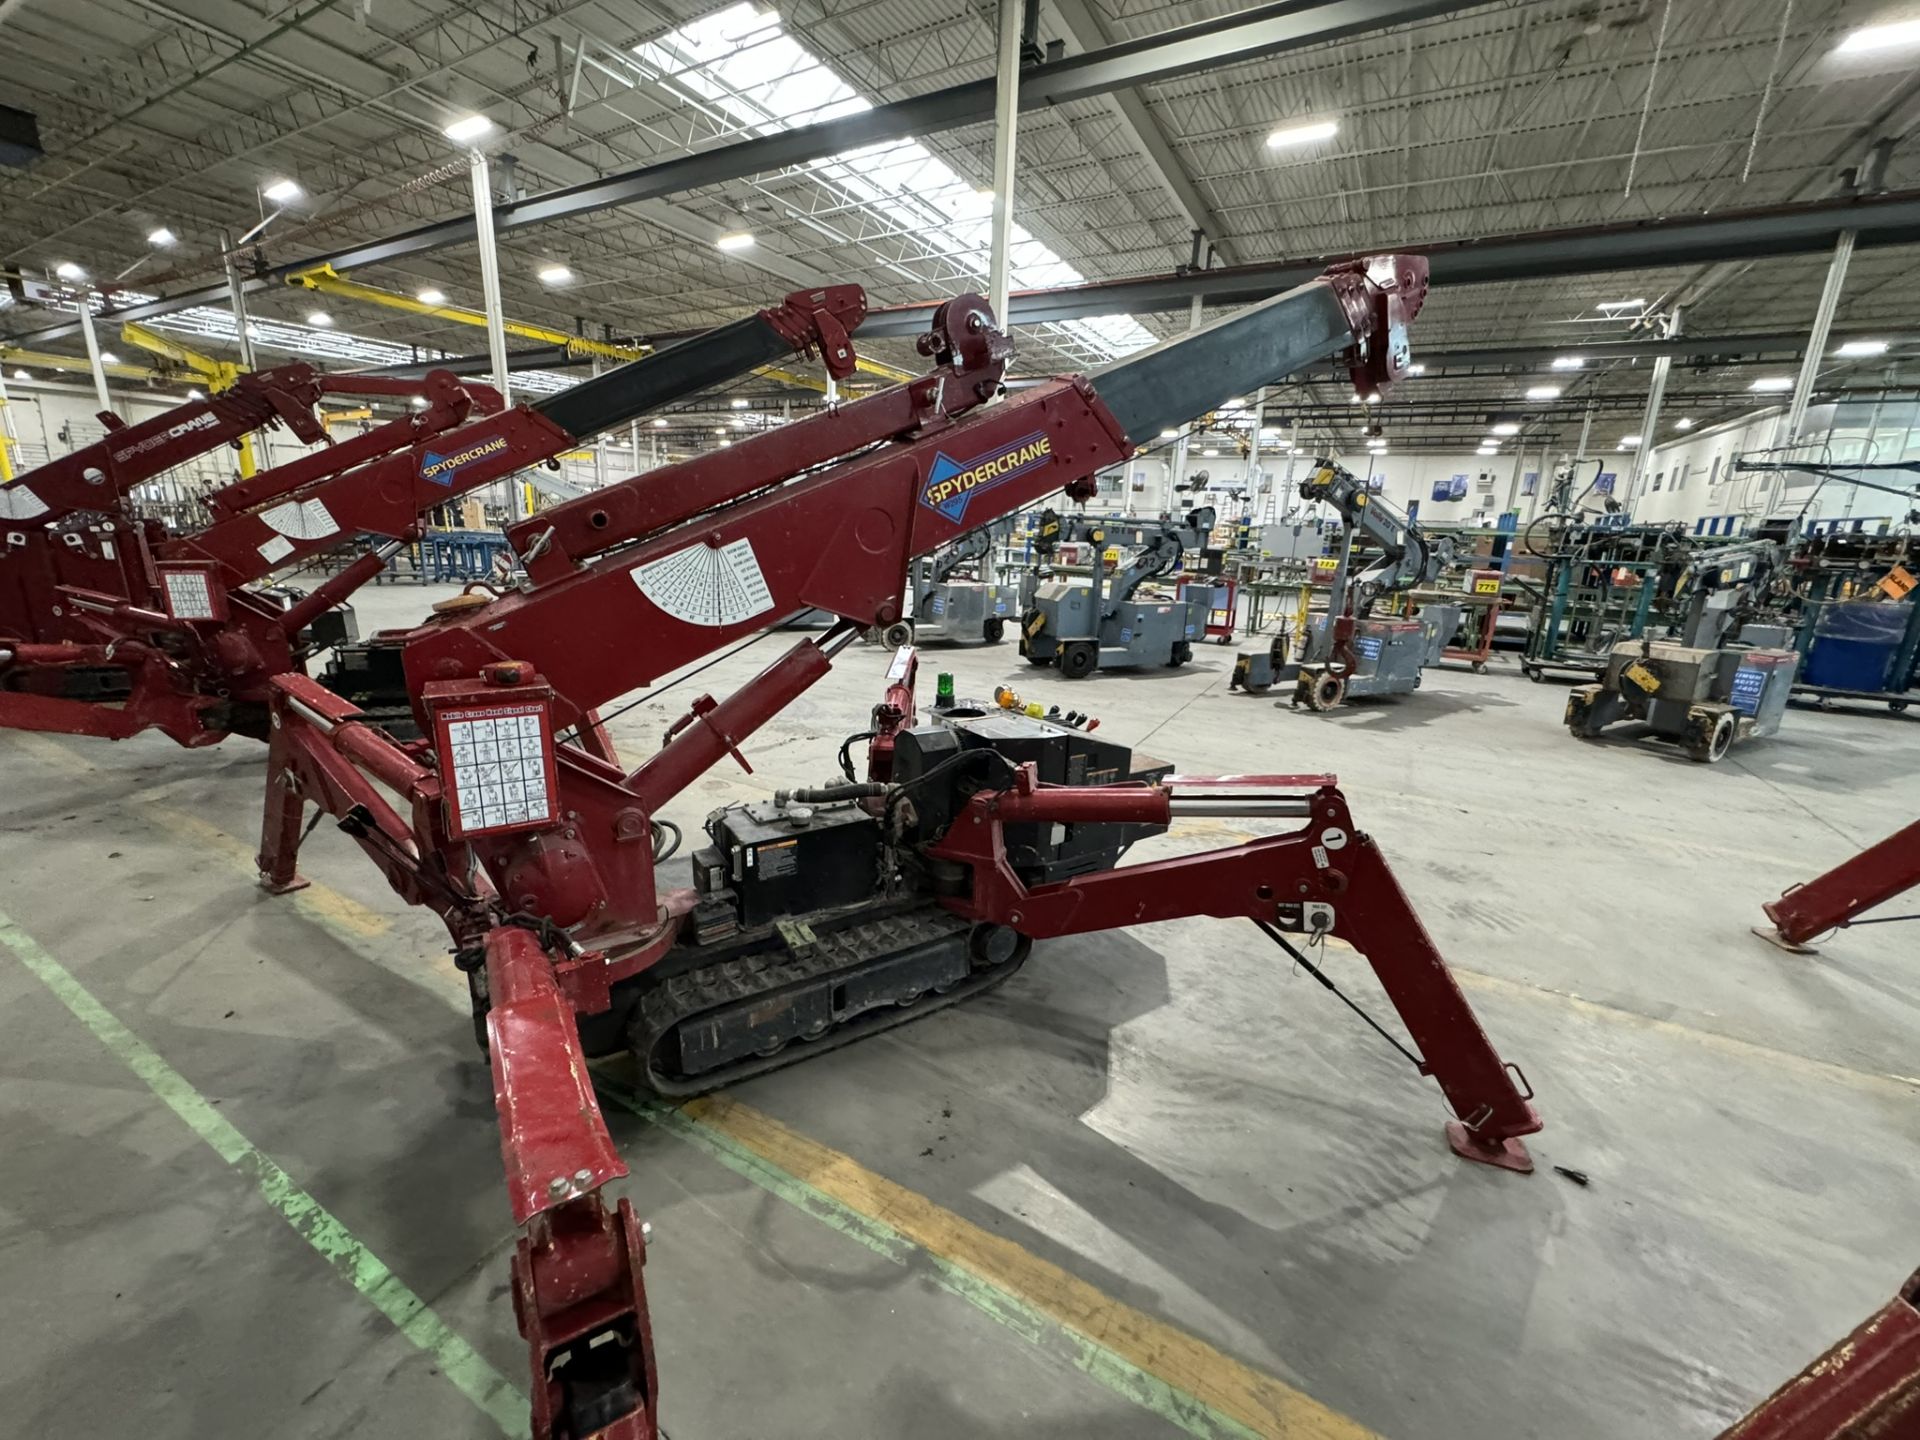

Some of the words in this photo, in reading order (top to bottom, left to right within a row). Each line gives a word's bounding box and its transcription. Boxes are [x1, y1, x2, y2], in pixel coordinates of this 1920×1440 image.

[423, 438, 508, 478] SPYDERCRANE
[926, 437, 1051, 506] SPYDERCRANE
[1477, 583, 1497, 591] 775
[440, 711, 464, 721] Mobile
[465, 710, 486, 719] Crane
[503, 706, 525, 715] Signal
[525, 704, 544, 713] Chart
[1325, 833, 1343, 842] 1
